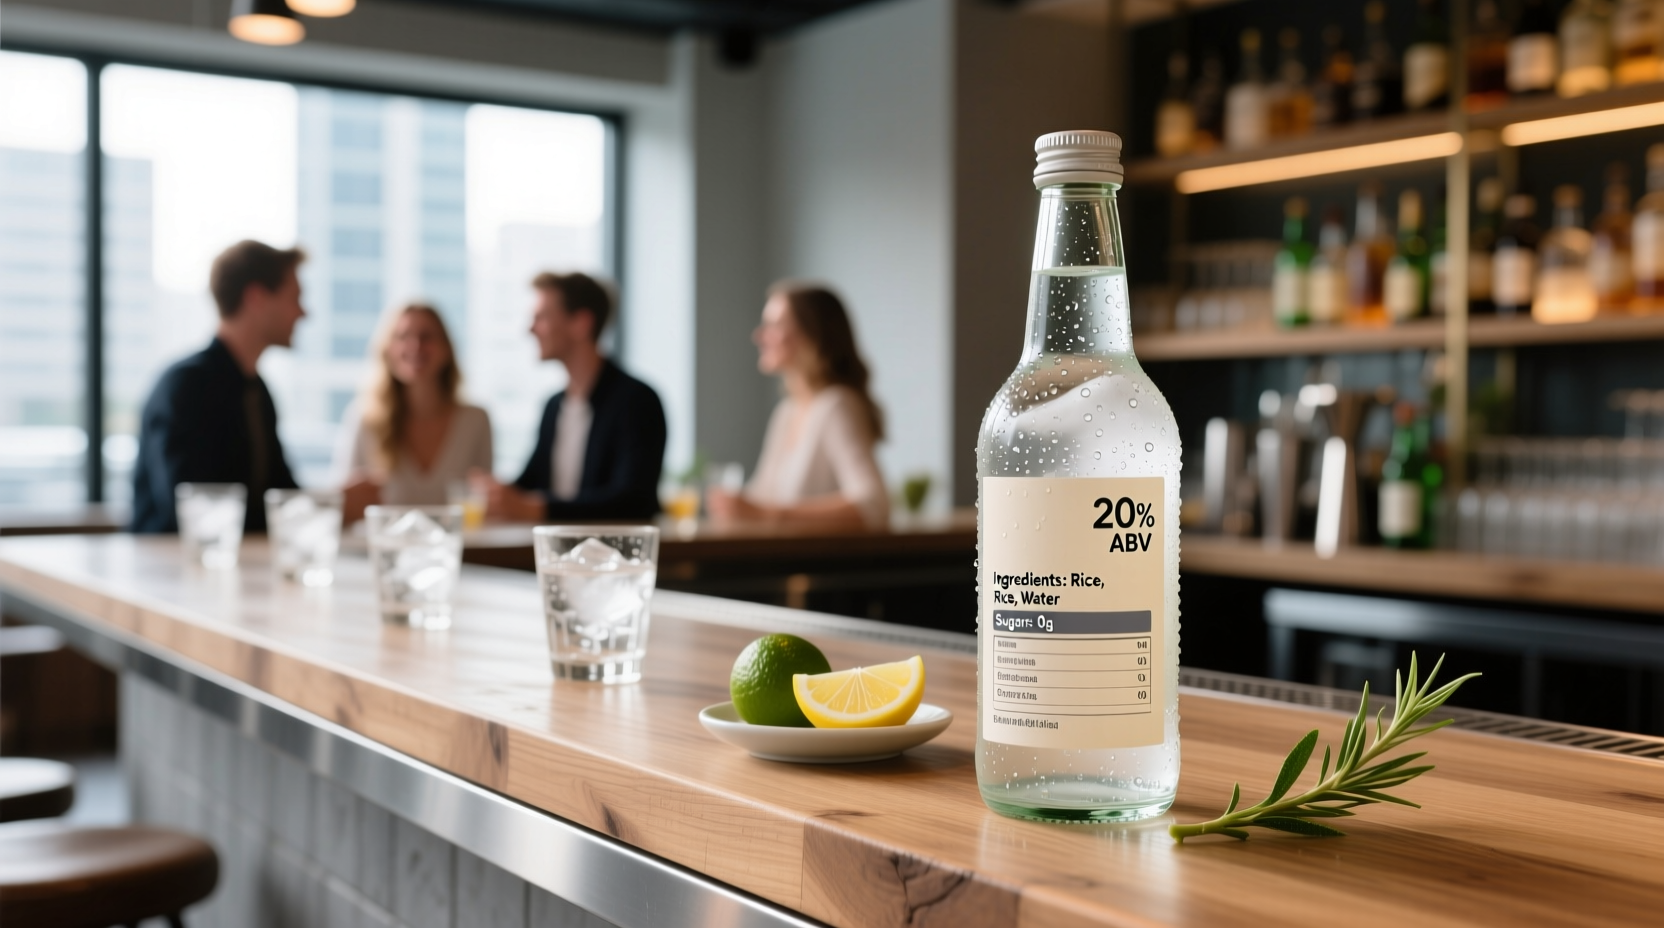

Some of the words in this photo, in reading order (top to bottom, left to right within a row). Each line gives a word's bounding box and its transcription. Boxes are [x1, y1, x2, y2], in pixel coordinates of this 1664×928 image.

[1093, 497, 1155, 529] 20%
[1109, 533, 1152, 553] ABV
[993, 571, 1067, 590] Ingredients:
[1070, 573, 1105, 589] Rice,
[1020, 590, 1060, 606] Water
[1037, 614, 1054, 633] 0g
